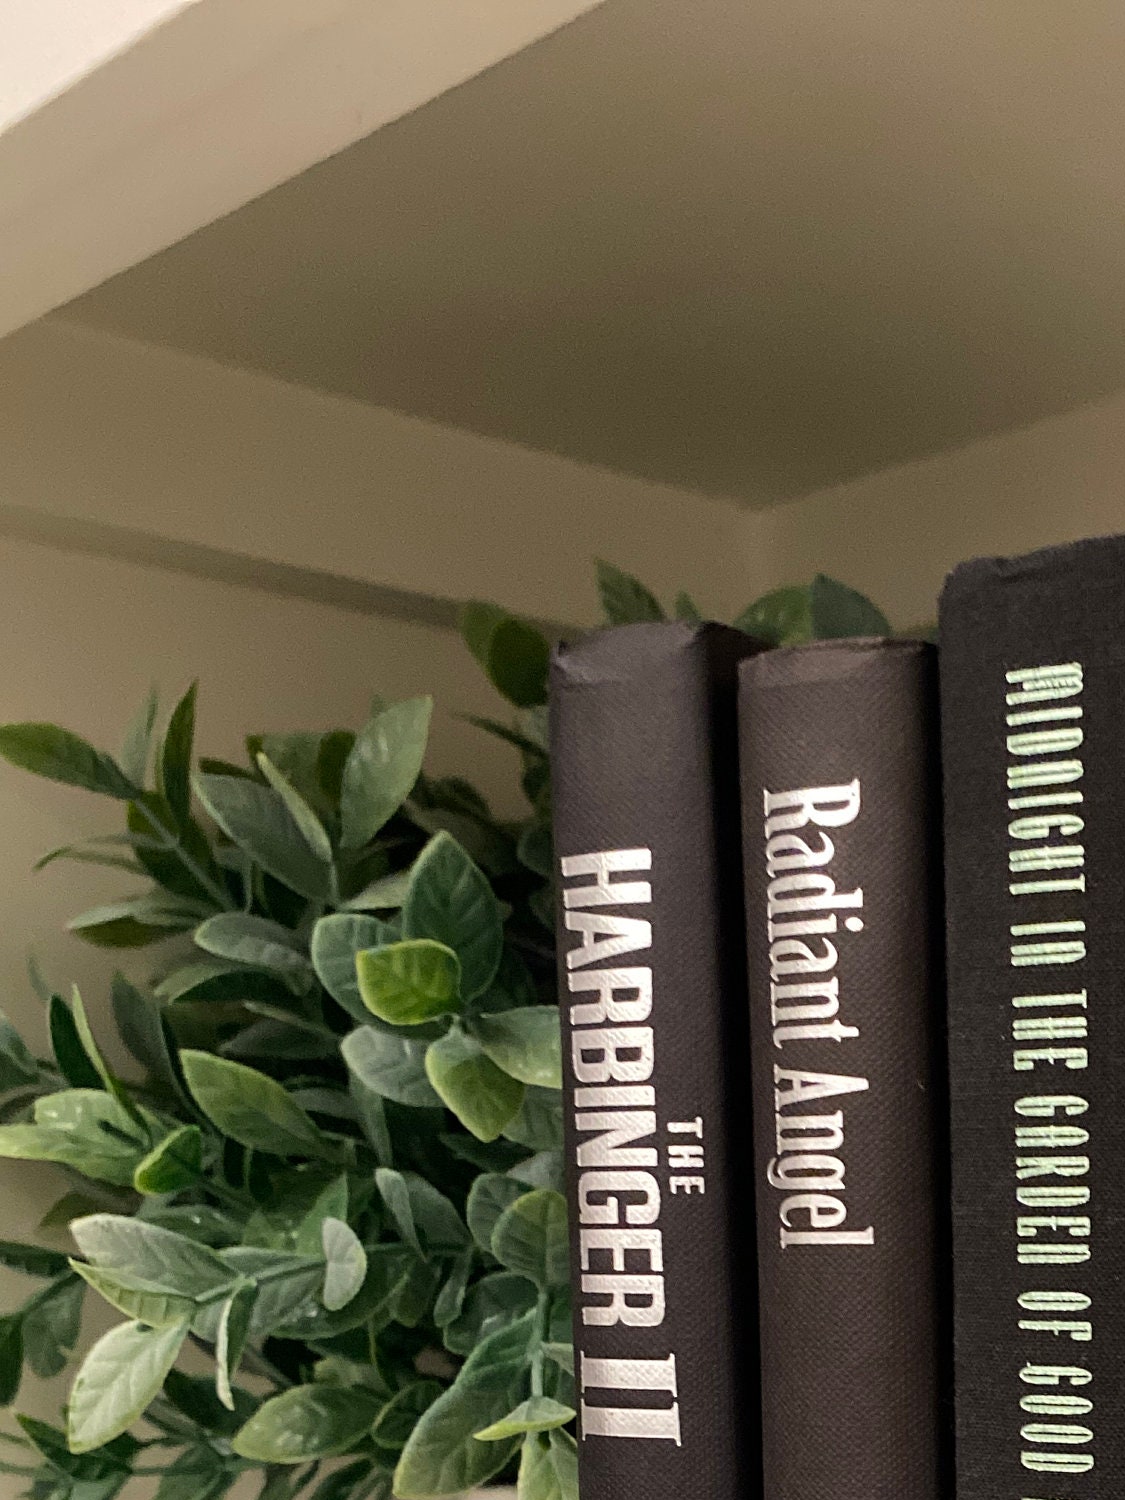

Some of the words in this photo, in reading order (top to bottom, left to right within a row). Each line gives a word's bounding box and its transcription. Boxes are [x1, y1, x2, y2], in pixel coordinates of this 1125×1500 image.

[1004, 661, 1086, 896] MIDNIGHT
[763, 777, 864, 1048] Radiant
[1010, 920, 1087, 967] IN
[1011, 988, 1088, 1071] THE
[559, 847, 666, 1328] HARBINGER
[666, 1116, 705, 1196] THE
[768, 1063, 875, 1250] Angel
[1013, 1095, 1092, 1265] GARDEN
[1016, 1291, 1093, 1342] OF
[580, 1350, 682, 1447] II
[1018, 1361, 1095, 1473] GOOD
